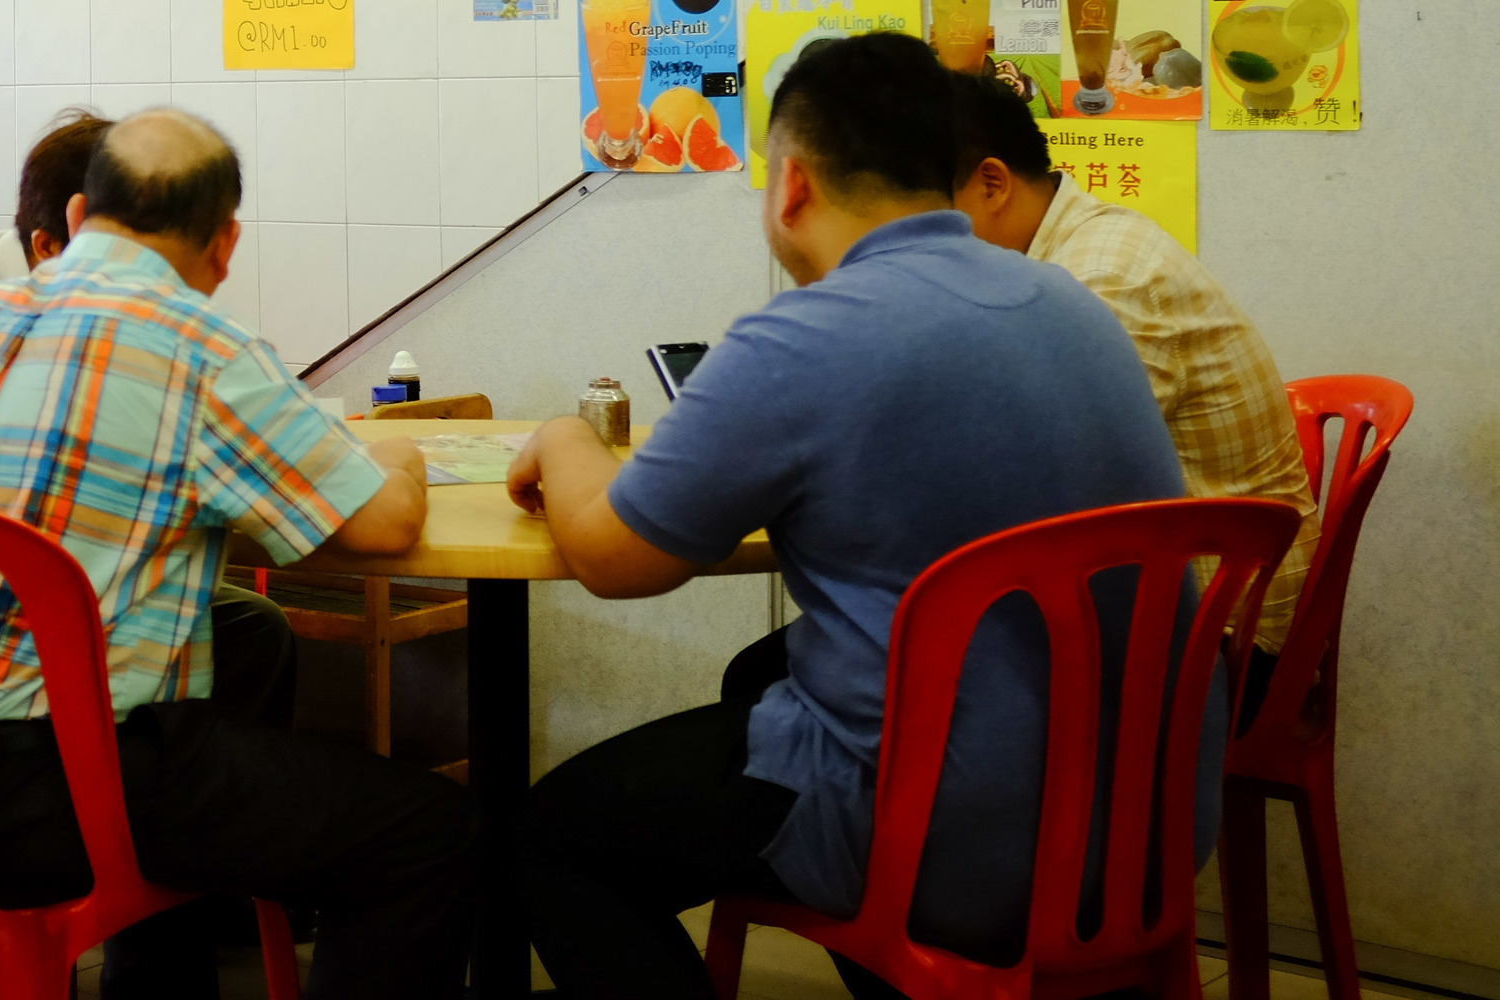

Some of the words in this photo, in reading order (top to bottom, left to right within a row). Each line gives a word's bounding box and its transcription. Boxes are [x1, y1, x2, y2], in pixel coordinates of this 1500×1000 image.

[605, 20, 627, 34] Red
[628, 20, 708, 39] GrapeFruit
[818, 16, 840, 30] Kui
[844, 16, 873, 31] Ling
[878, 14, 906, 30] Kao
[629, 42, 680, 57] Passion
[686, 41, 737, 58] Poping
[998, 35, 1048, 53] Lemon
[1103, 133, 1145, 147] Here
